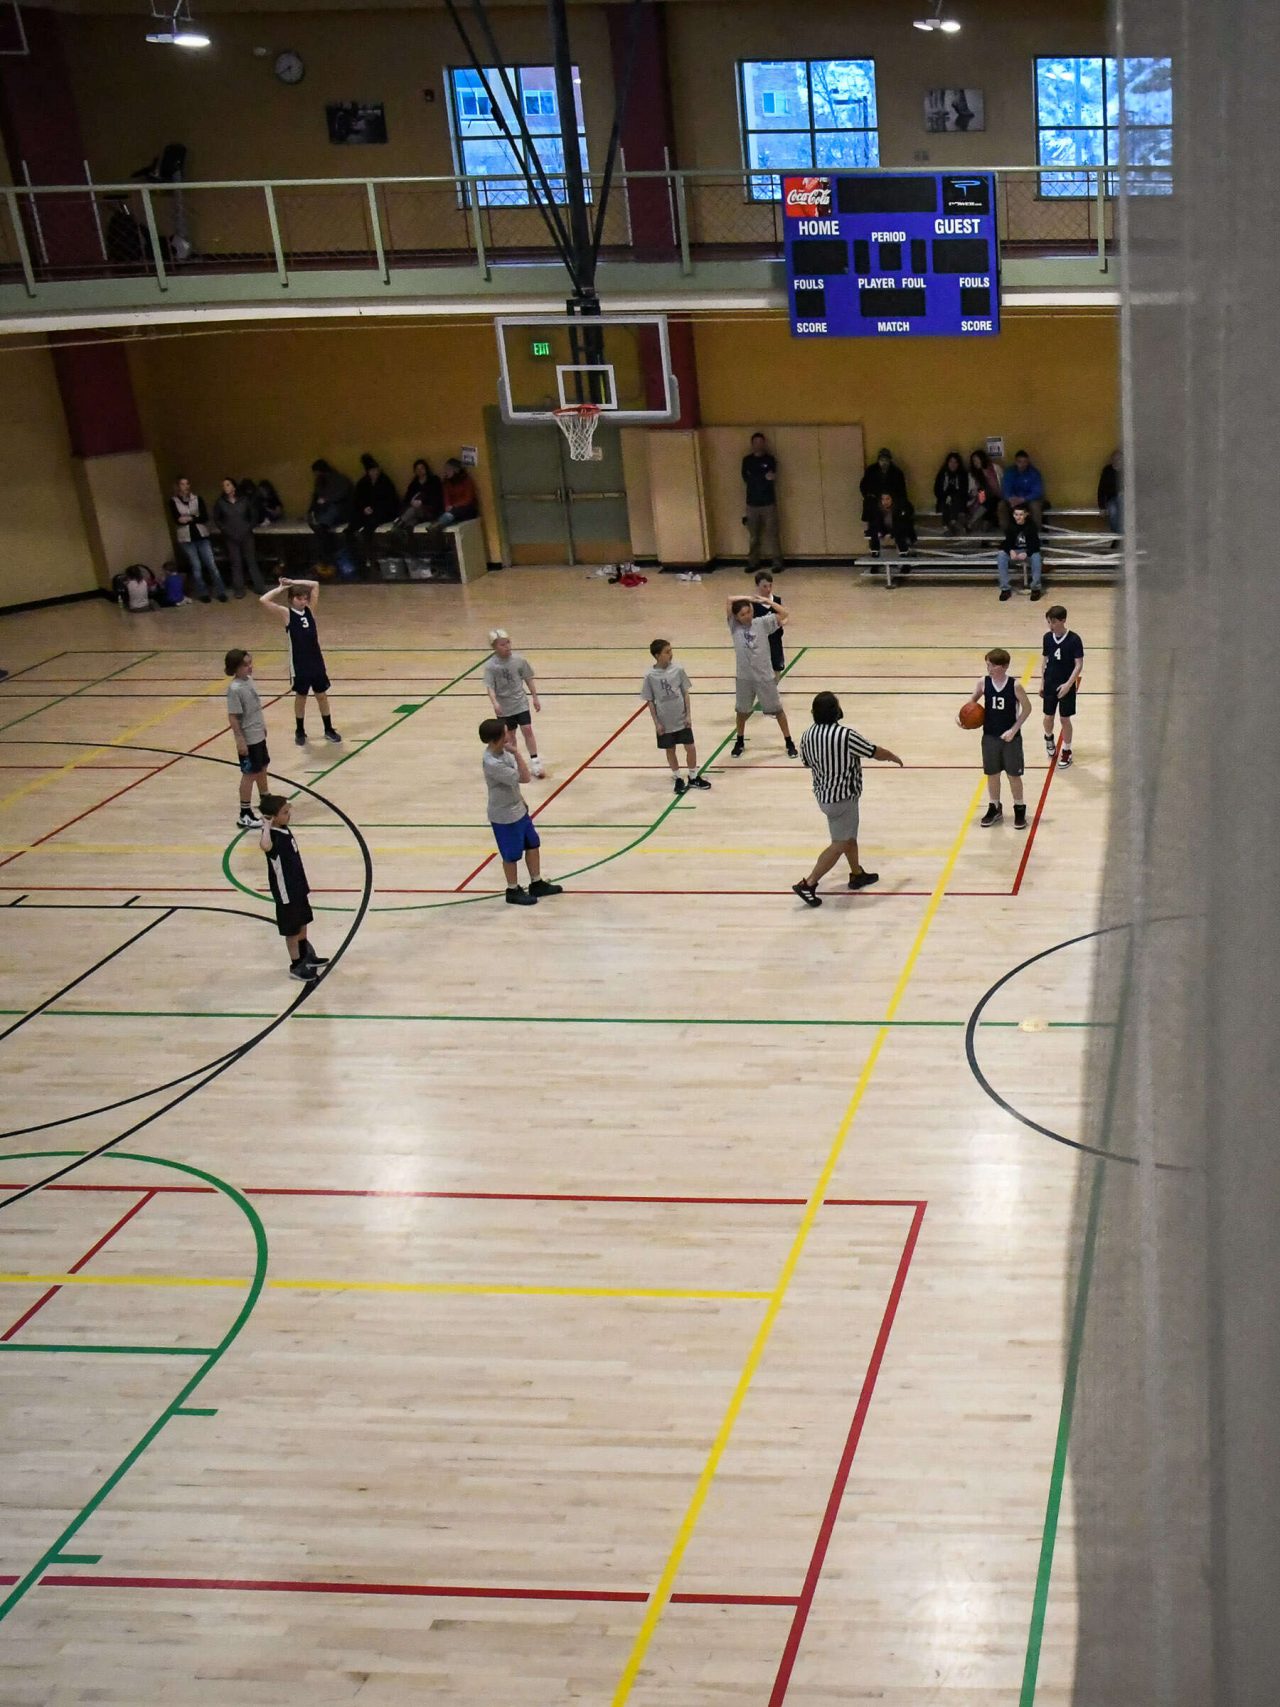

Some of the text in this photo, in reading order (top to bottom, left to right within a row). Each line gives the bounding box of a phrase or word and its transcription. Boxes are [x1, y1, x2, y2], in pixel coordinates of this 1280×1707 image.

[798, 220, 840, 236] HOME
[934, 218, 981, 234] GUEST
[871, 231, 907, 243] PERIOD
[793, 278, 825, 290] FOULS
[857, 277, 927, 289] PLAYER FOUL
[959, 276, 990, 288] FOULS
[796, 322, 828, 333] SCORE
[877, 321, 910, 332] MATCH
[960, 320, 993, 332] SCORE
[300, 616, 310, 628] 3
[1054, 647, 1061, 660] 4
[991, 696, 1005, 710] 13
